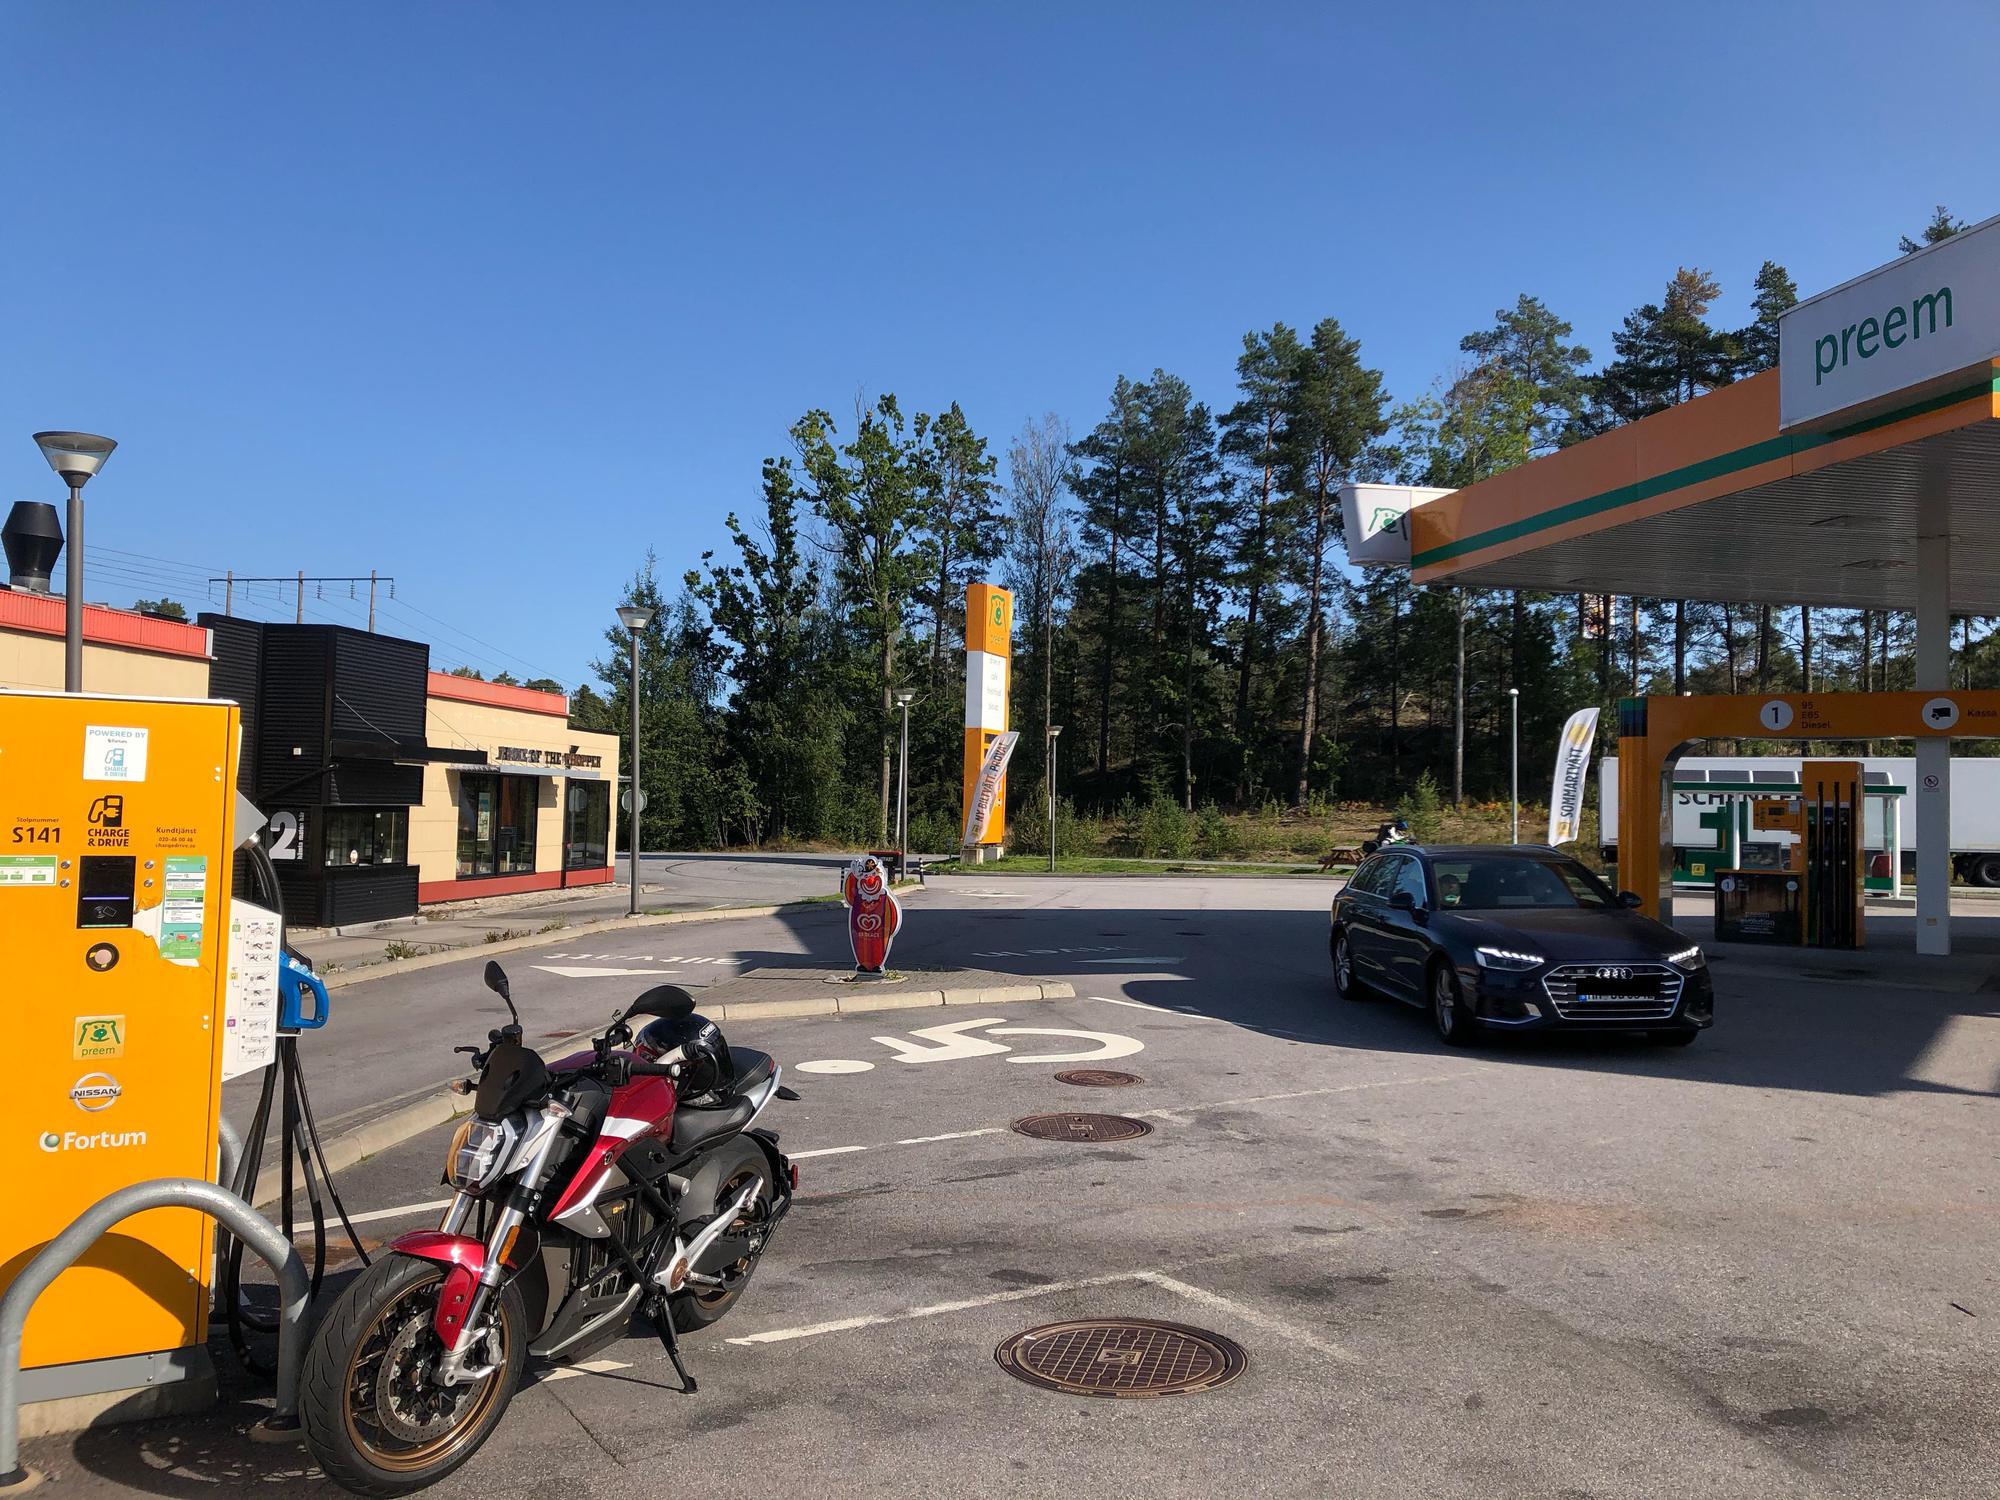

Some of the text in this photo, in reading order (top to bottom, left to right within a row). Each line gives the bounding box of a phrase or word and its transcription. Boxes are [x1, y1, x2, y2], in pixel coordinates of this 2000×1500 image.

[1815, 287, 1953, 386] preem
[1771, 707, 1779, 724] 1
[89, 729, 133, 738] POWERED
[544, 750, 562, 765] THE
[975, 807, 985, 823] NY
[12, 827, 61, 843] S141
[87, 828, 130, 838] CHARGE
[156, 826, 197, 835] Kundtjänst
[269, 811, 297, 859] 2
[87, 838, 129, 847] & DRIVE
[81, 1045, 116, 1057] preem
[74, 1088, 117, 1097] NISSAN
[63, 1130, 147, 1151] Fortum
